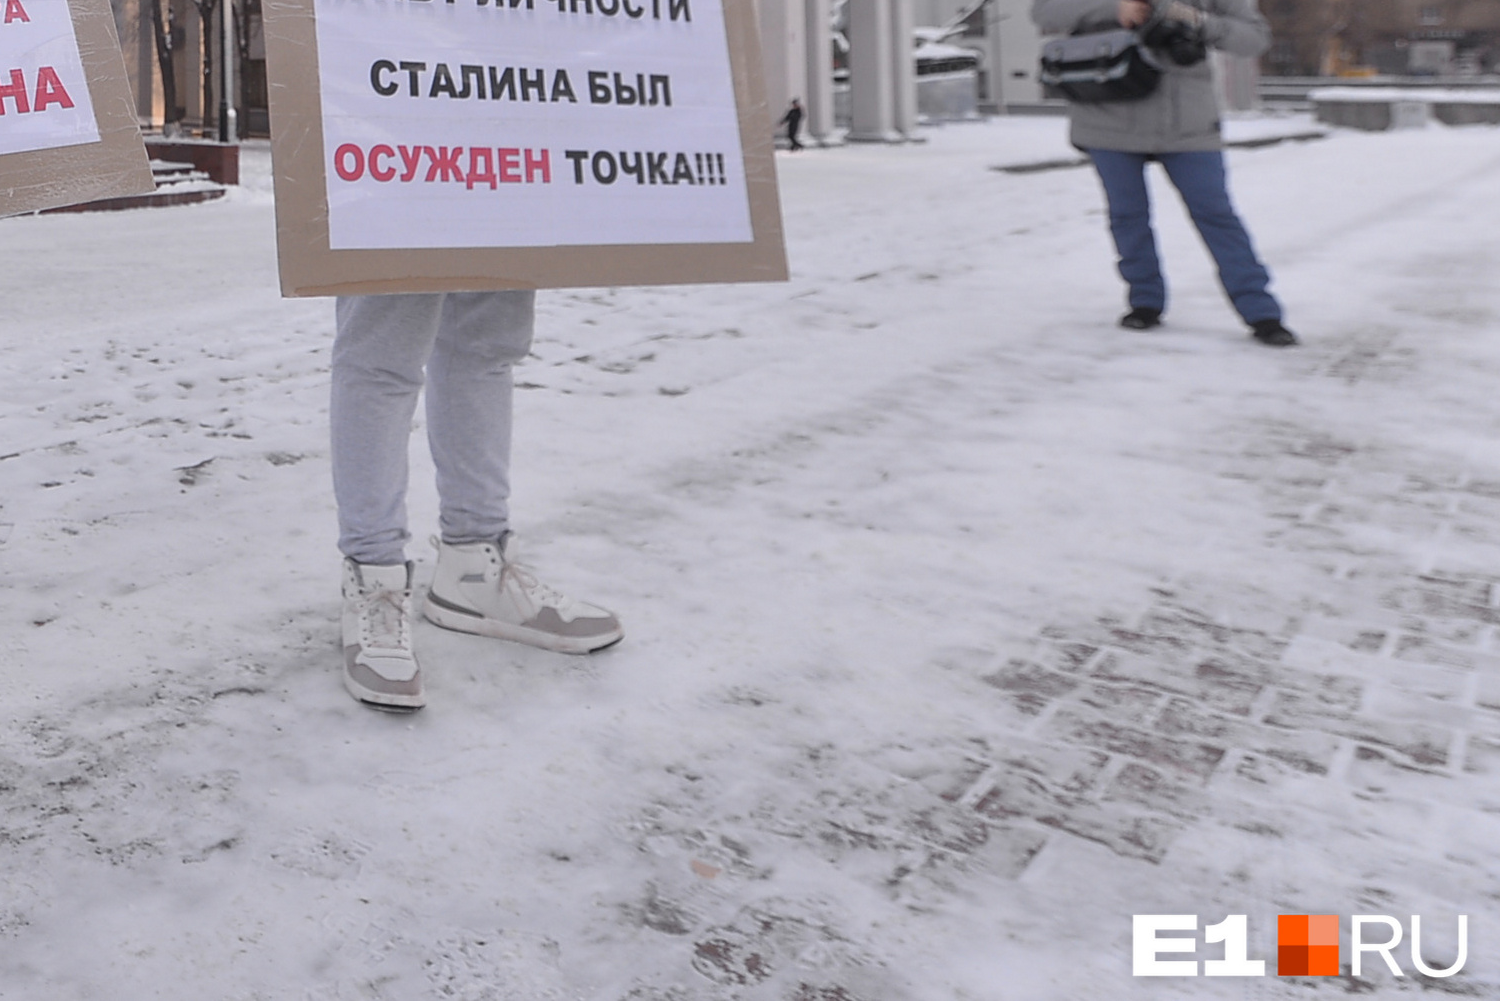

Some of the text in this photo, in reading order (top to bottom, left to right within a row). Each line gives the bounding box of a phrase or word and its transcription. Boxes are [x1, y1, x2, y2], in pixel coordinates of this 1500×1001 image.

[370, 59, 672, 107] СТАЛИНА БЫЛ
[333, 142, 727, 191] ОСУЖДЕН ТОЧКА!!!
